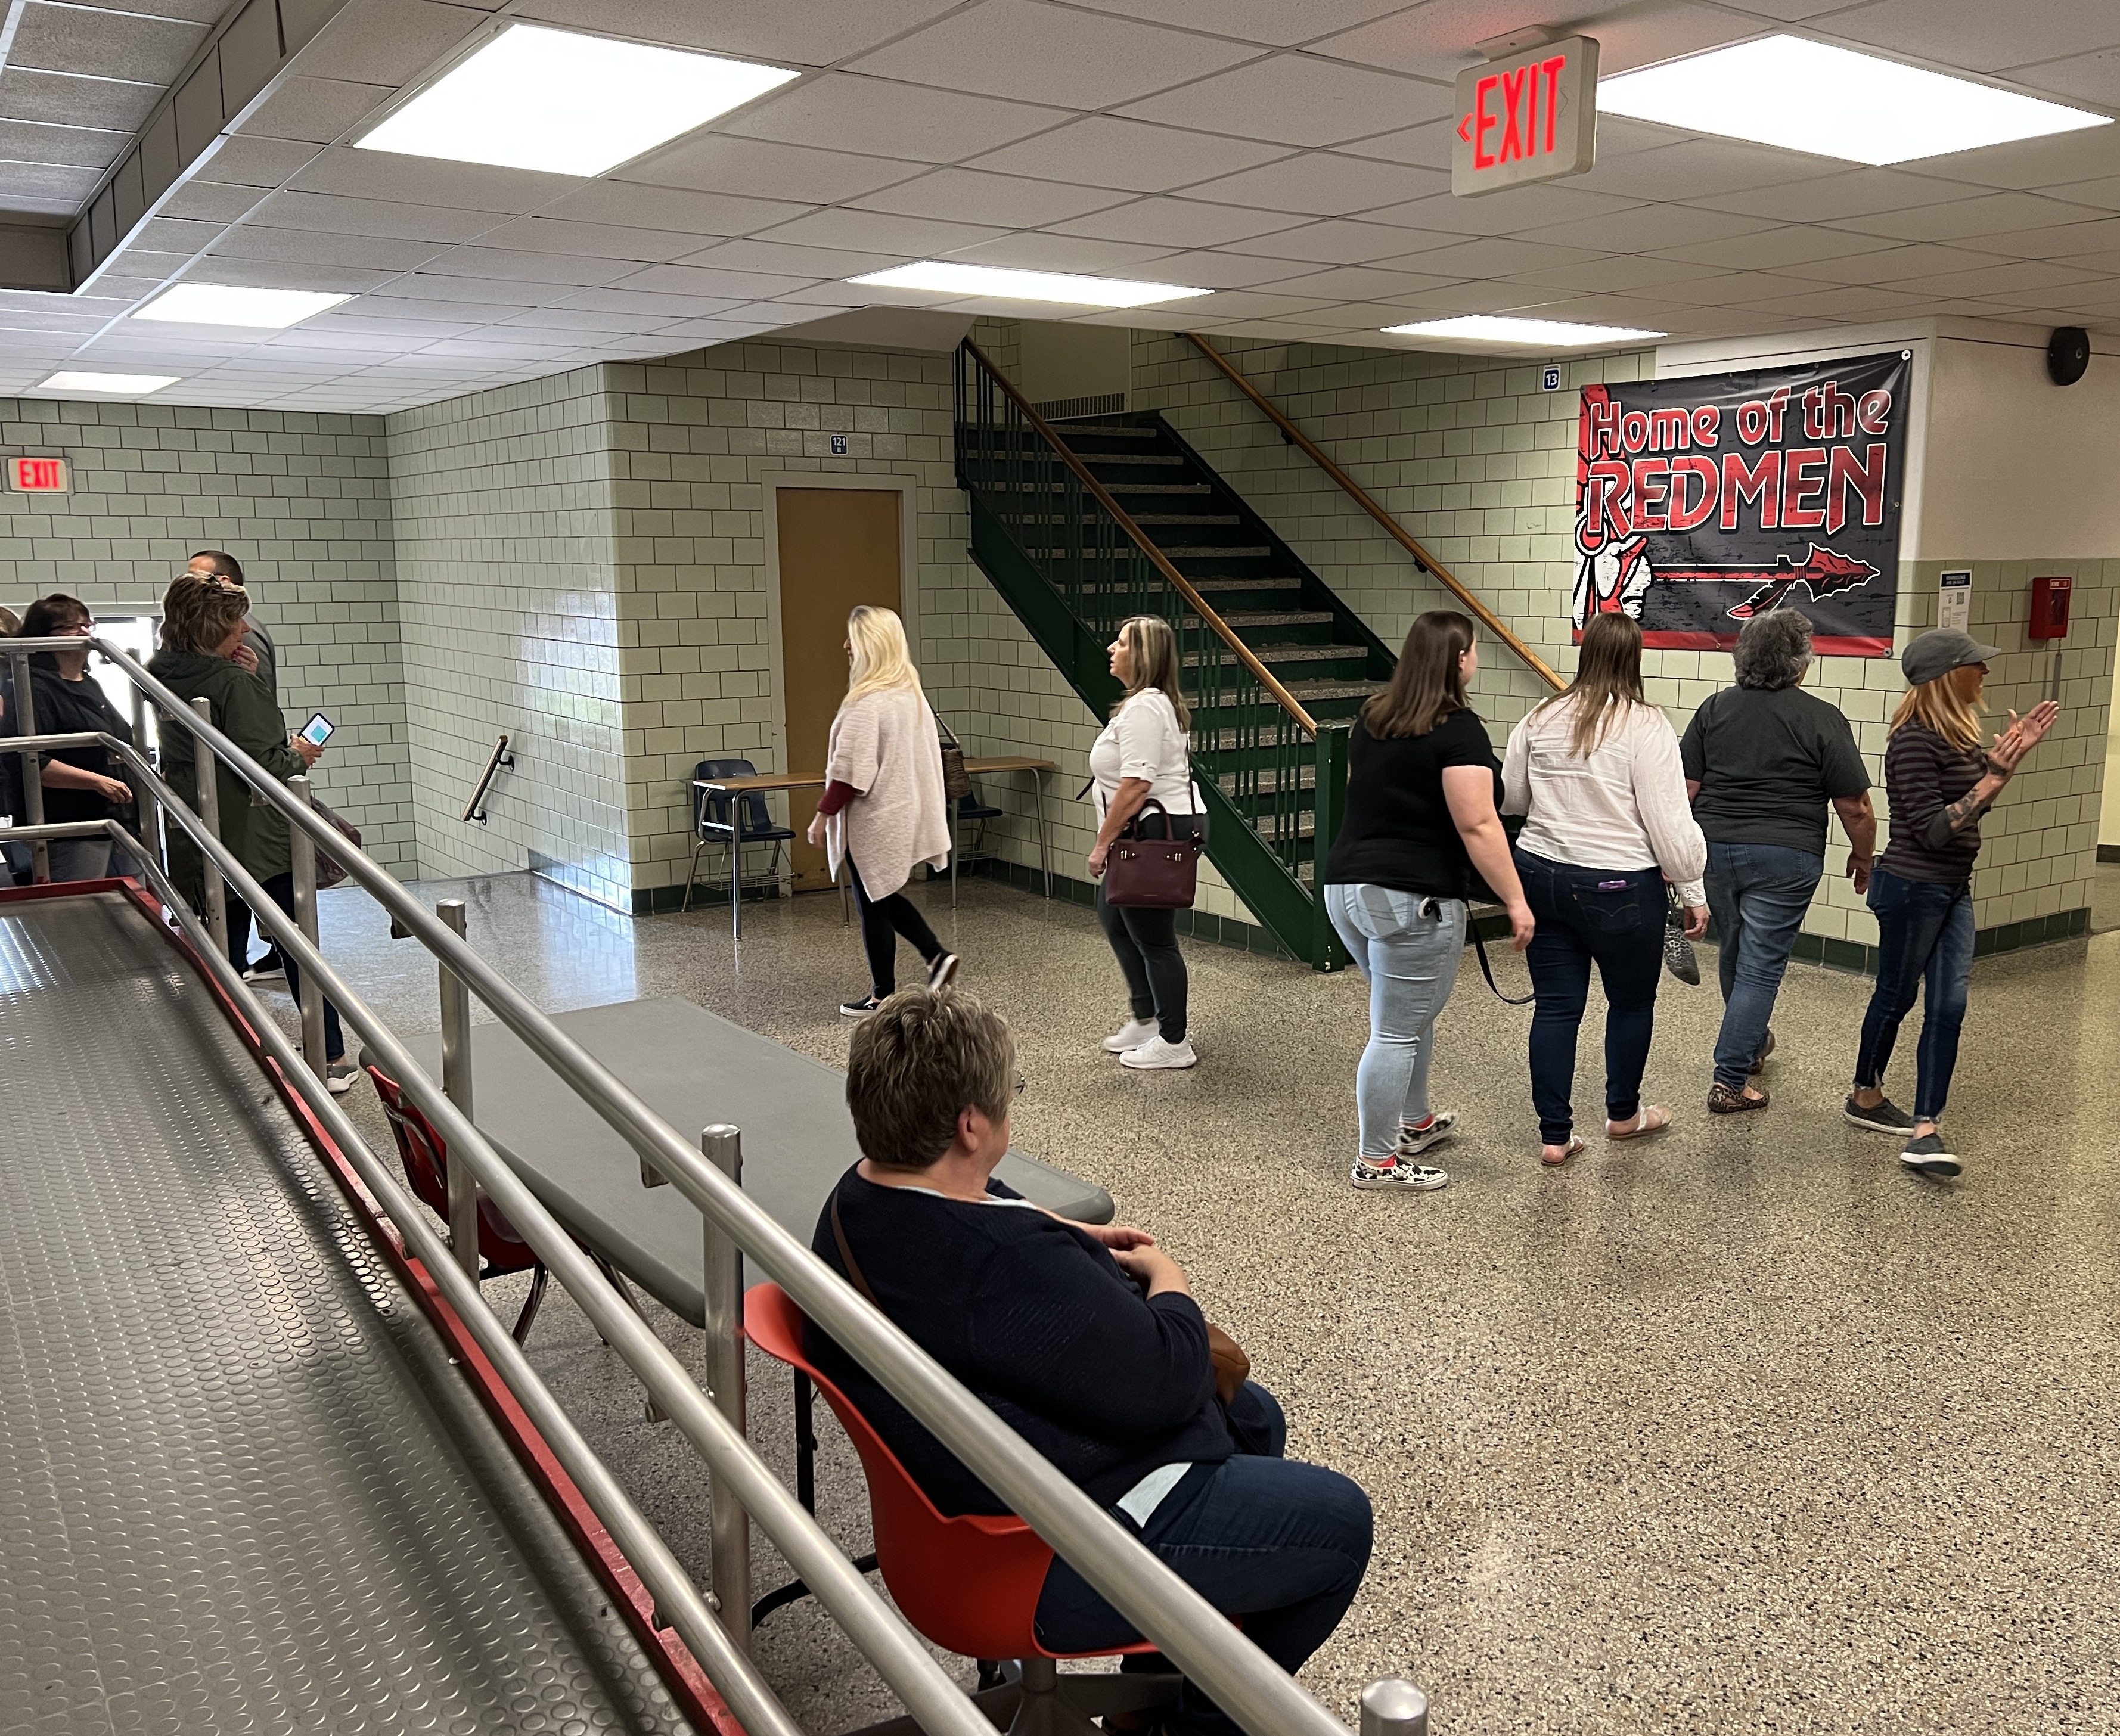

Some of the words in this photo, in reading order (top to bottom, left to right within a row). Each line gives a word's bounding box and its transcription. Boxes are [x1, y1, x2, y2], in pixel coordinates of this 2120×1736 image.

[1474, 55, 1566, 170] EXIT
[1545, 373, 1557, 386] 13
[833, 437, 846, 446] 121
[1590, 400, 1720, 459] Home
[1737, 386, 1791, 445] of
[1803, 381, 1892, 439] the
[18, 459, 59, 489] EXIT
[1587, 443, 1886, 539] REDMEN
